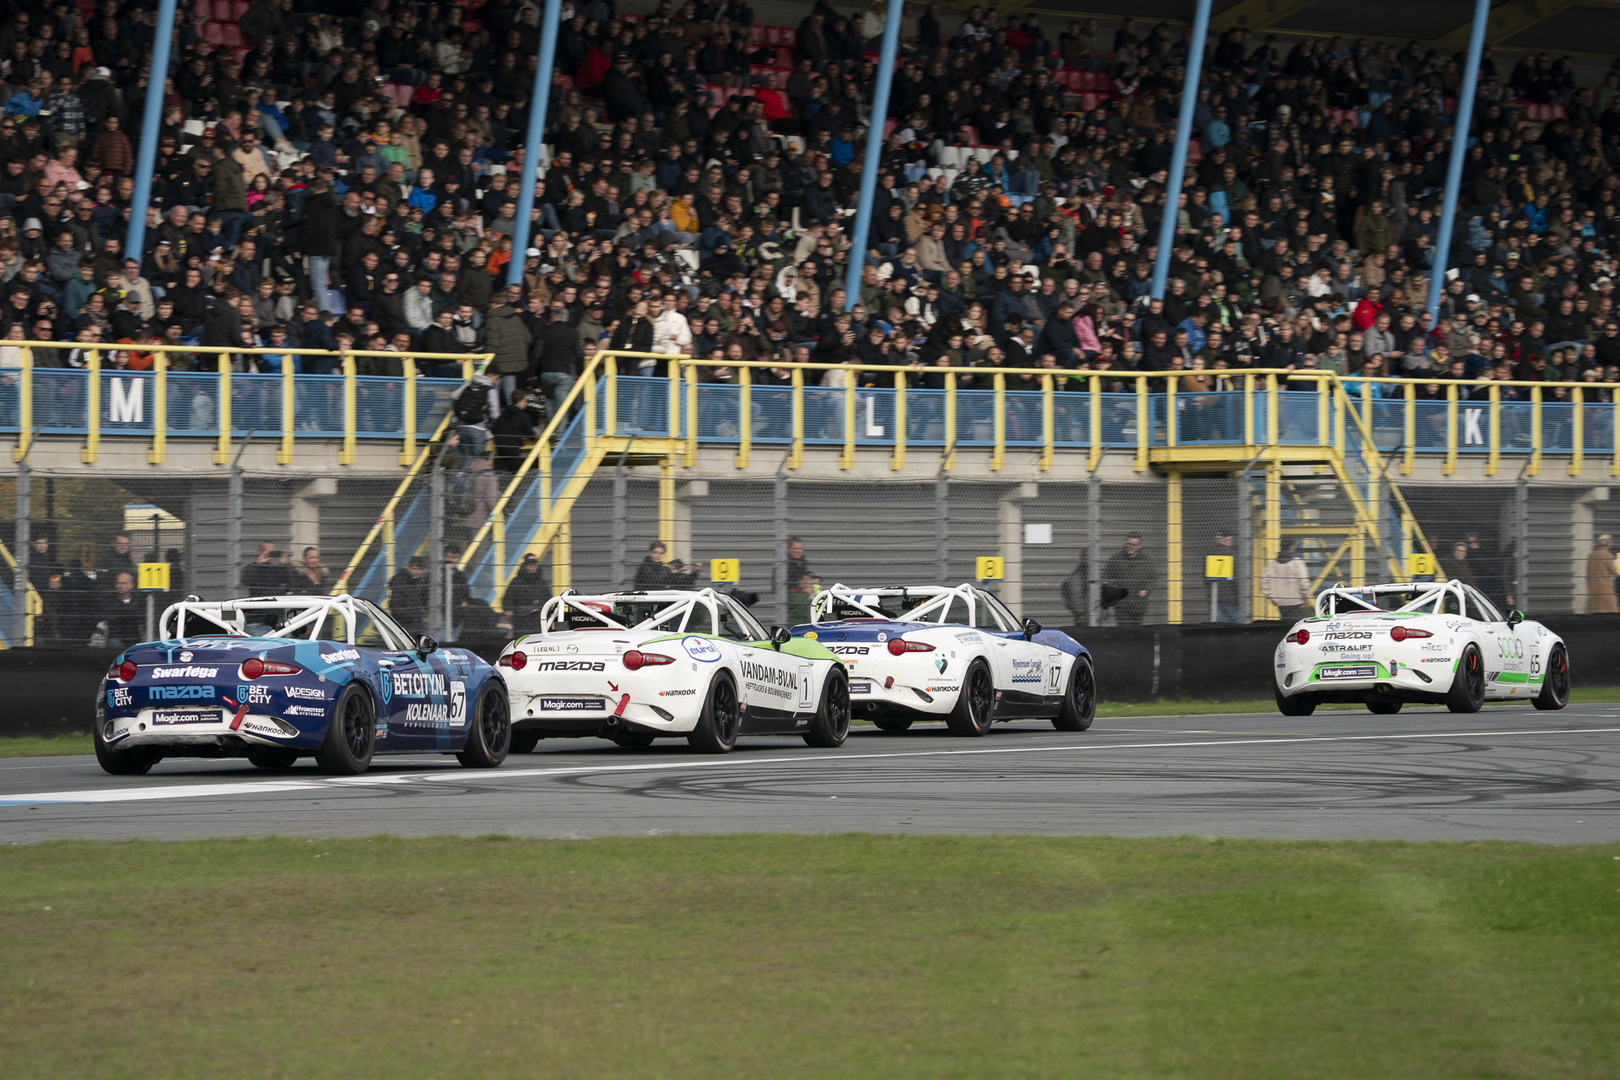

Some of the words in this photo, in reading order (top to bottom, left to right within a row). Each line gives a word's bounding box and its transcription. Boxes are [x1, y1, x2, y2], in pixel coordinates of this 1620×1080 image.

[110, 377, 144, 423] M
[866, 396, 885, 436] L
[1464, 408, 1484, 445] K
[717, 561, 730, 581] 9
[983, 559, 997, 578] 8
[1215, 559, 1226, 576] 7
[1415, 556, 1429, 574] 6
[144, 566, 164, 587] 11
[1324, 631, 1373, 640] mazda
[1321, 644, 1373, 652] ASTRALIFT
[151, 666, 218, 679] Swarfega
[538, 661, 606, 672] mazda
[1530, 654, 1540, 674] 65
[740, 660, 798, 690] VANDAM-BV.NL
[1050, 666, 1061, 687] 17
[114, 687, 129, 698] BET
[149, 685, 215, 699] mazda
[249, 685, 269, 694] BET
[393, 673, 448, 696] BETCITY.NL
[665, 689, 697, 697] HANKOOK
[803, 677, 808, 700] 1
[115, 695, 133, 707] CITY
[249, 695, 272, 704] CITY
[451, 692, 465, 718] 67
[406, 703, 448, 721] KOLENAAR
